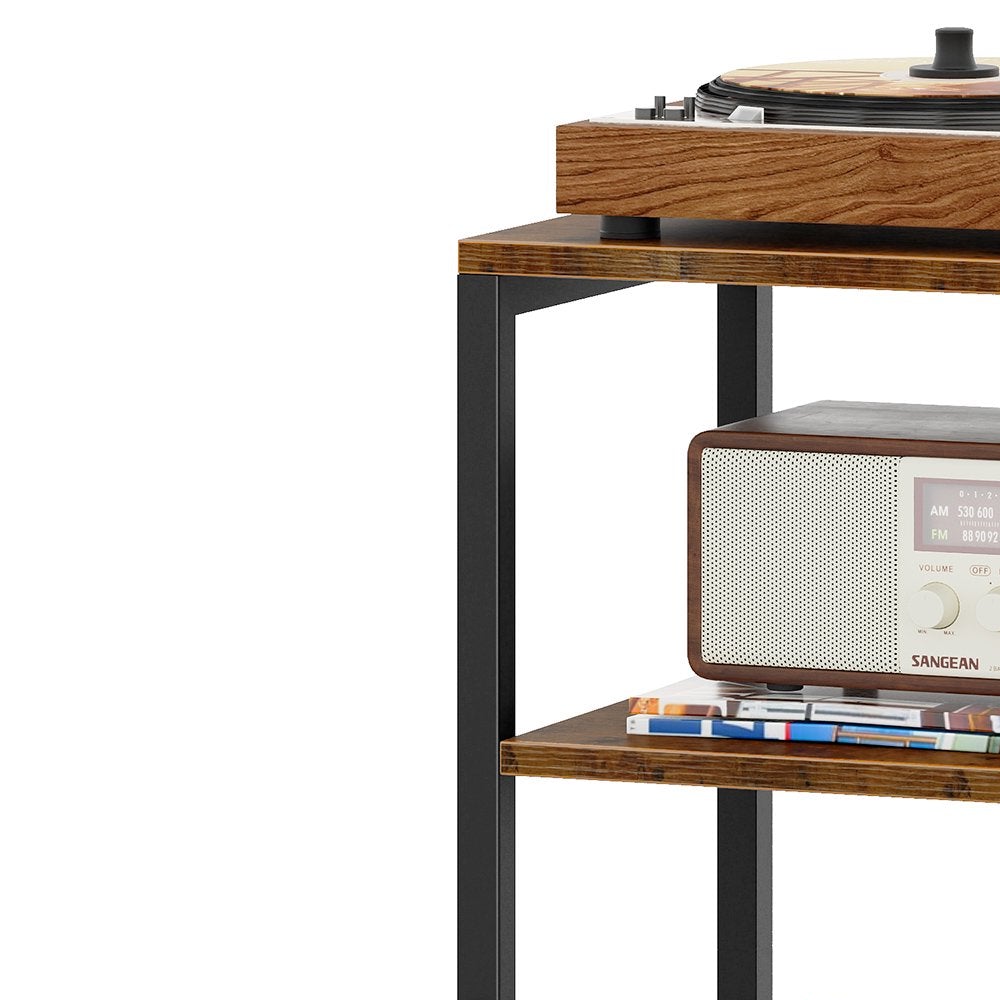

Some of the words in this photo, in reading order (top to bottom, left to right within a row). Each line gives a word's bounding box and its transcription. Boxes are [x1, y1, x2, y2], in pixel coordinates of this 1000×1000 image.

[930, 505, 949, 516] AM
[958, 505, 974, 518] 530
[977, 506, 994, 518] 600
[931, 528, 948, 540] FM
[962, 530, 974, 542] 88
[975, 530, 986, 542] 90
[987, 531, 998, 543] 92
[919, 564, 954, 573] VOLUME
[972, 566, 989, 575] OFF
[912, 654, 980, 670] SANGEAN
